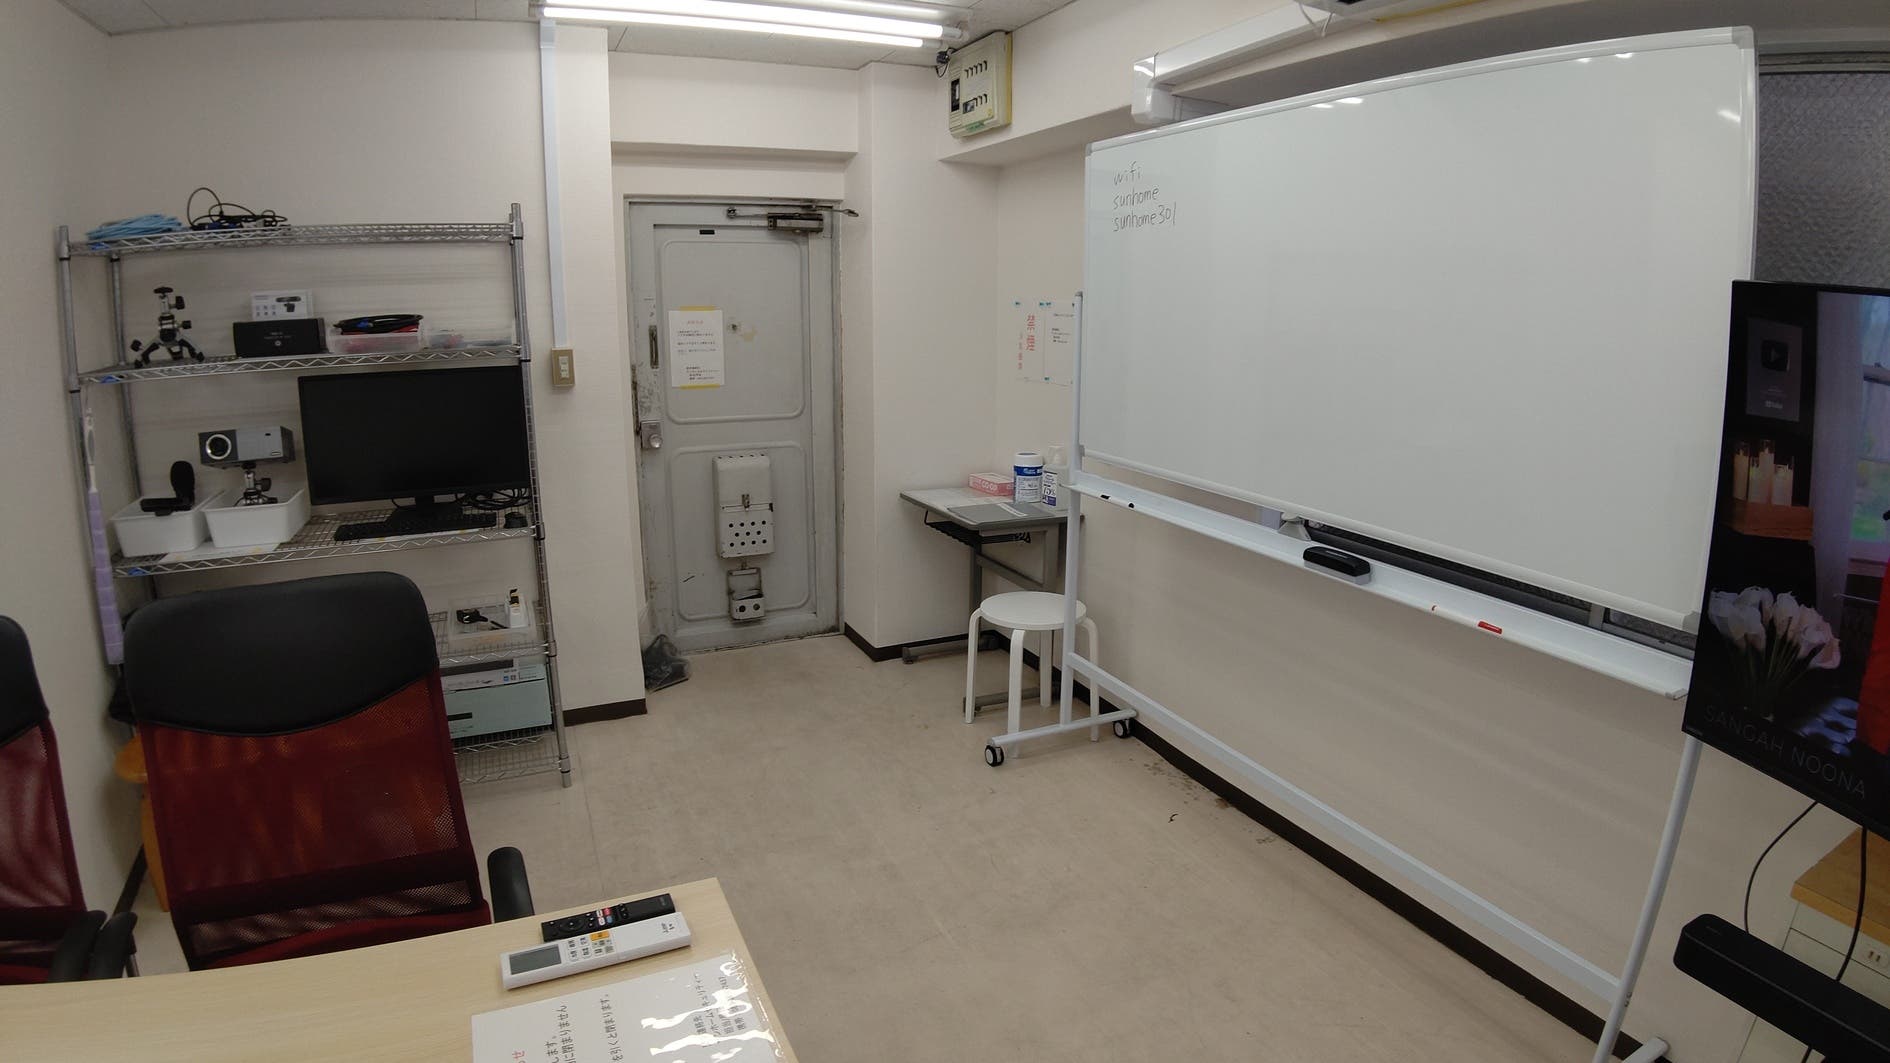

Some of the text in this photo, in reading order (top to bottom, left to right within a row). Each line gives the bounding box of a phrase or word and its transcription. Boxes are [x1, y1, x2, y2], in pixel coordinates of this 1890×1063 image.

[1113, 160, 1143, 186] wifi
[1112, 186, 1160, 210] sunhome
[1112, 201, 1177, 232] sunhome301
[1791, 746, 1866, 800] NOONA
